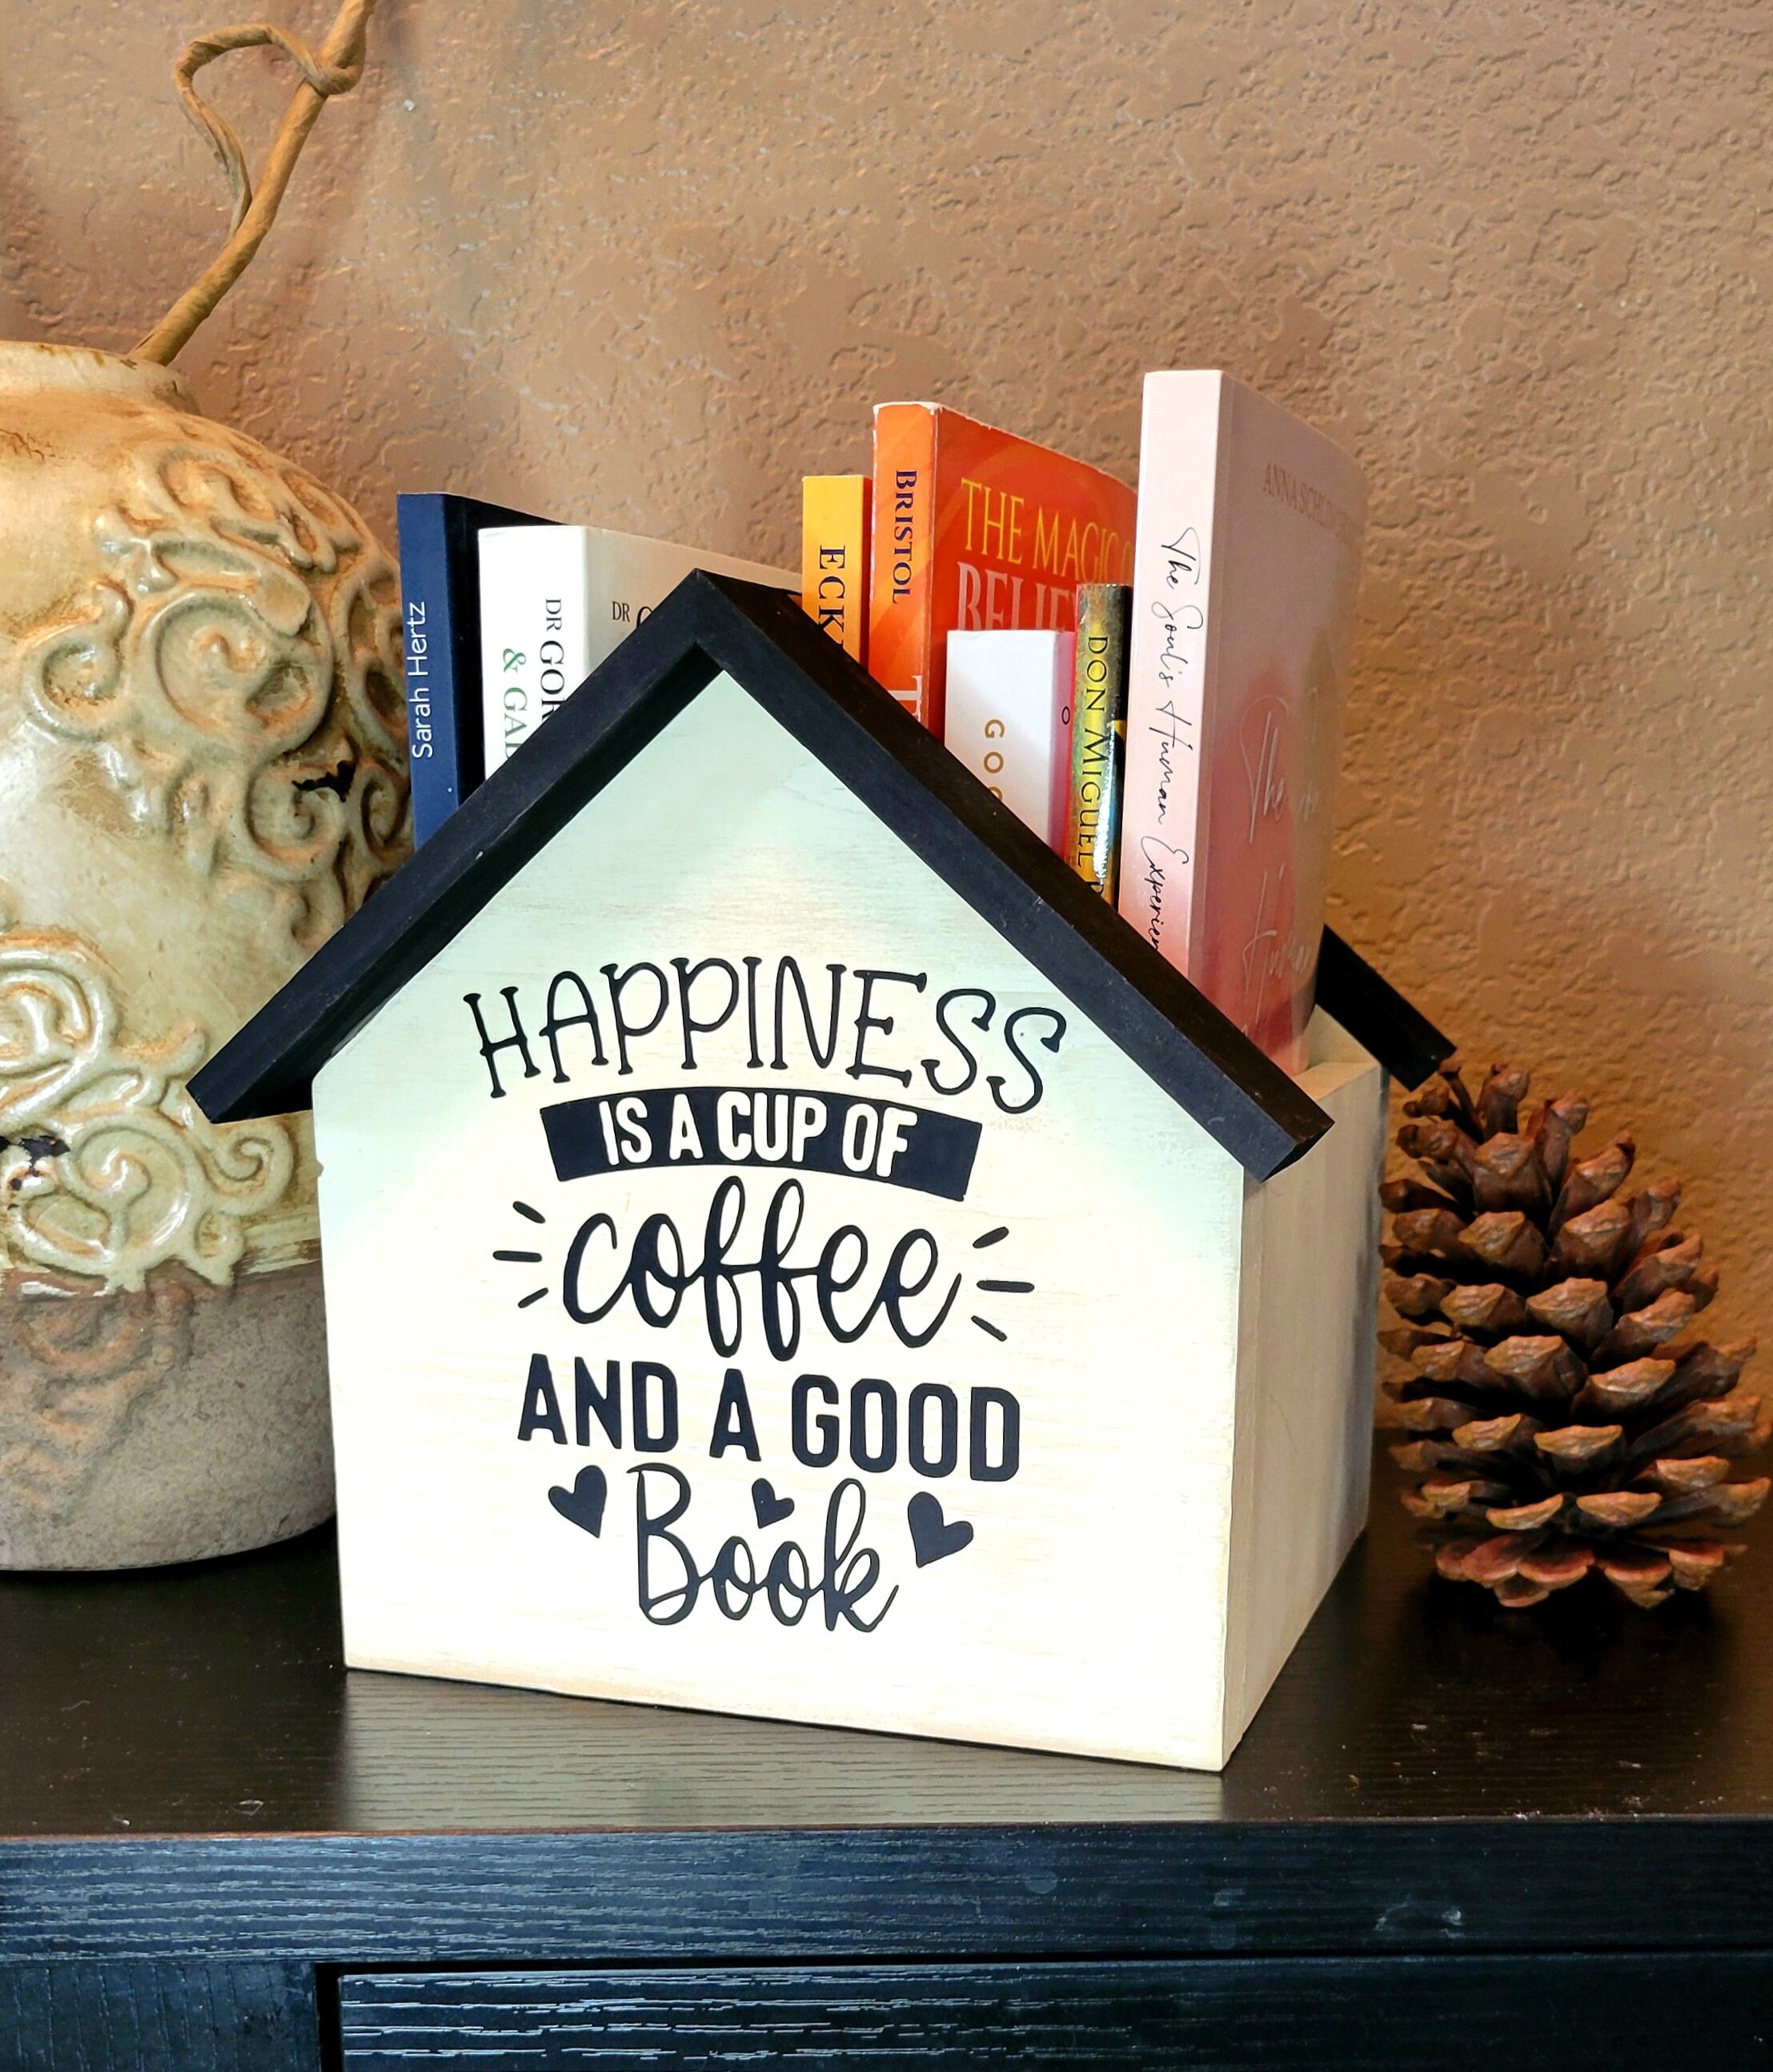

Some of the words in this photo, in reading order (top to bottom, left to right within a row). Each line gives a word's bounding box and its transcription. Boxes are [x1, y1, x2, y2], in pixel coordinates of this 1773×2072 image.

[893, 470, 917, 604] BRISTOL
[961, 477, 1025, 565] THE
[1031, 504, 1119, 584] MAGIC
[1161, 526, 1201, 590] The
[407, 600, 430, 677] Hertz
[545, 598, 563, 632] DR
[612, 601, 631, 622] DR
[1150, 601, 1204, 689] Soul's
[502, 648, 527, 673] &
[1085, 636, 1109, 712] DON
[409, 687, 434, 759] Sarah
[1149, 700, 1193, 825] Human
[463, 956, 1067, 1114] HAPPINESS
[599, 1099, 652, 1167] IS
[668, 1094, 704, 1161] A
[716, 1090, 828, 1164] CUP
[841, 1102, 918, 1178] OF
[562, 1175, 962, 1362] coffee
[517, 1353, 680, 1453] AND
[709, 1368, 762, 1462] A
[791, 1374, 1021, 1482] GOOD
[625, 1462, 900, 1633] Book
